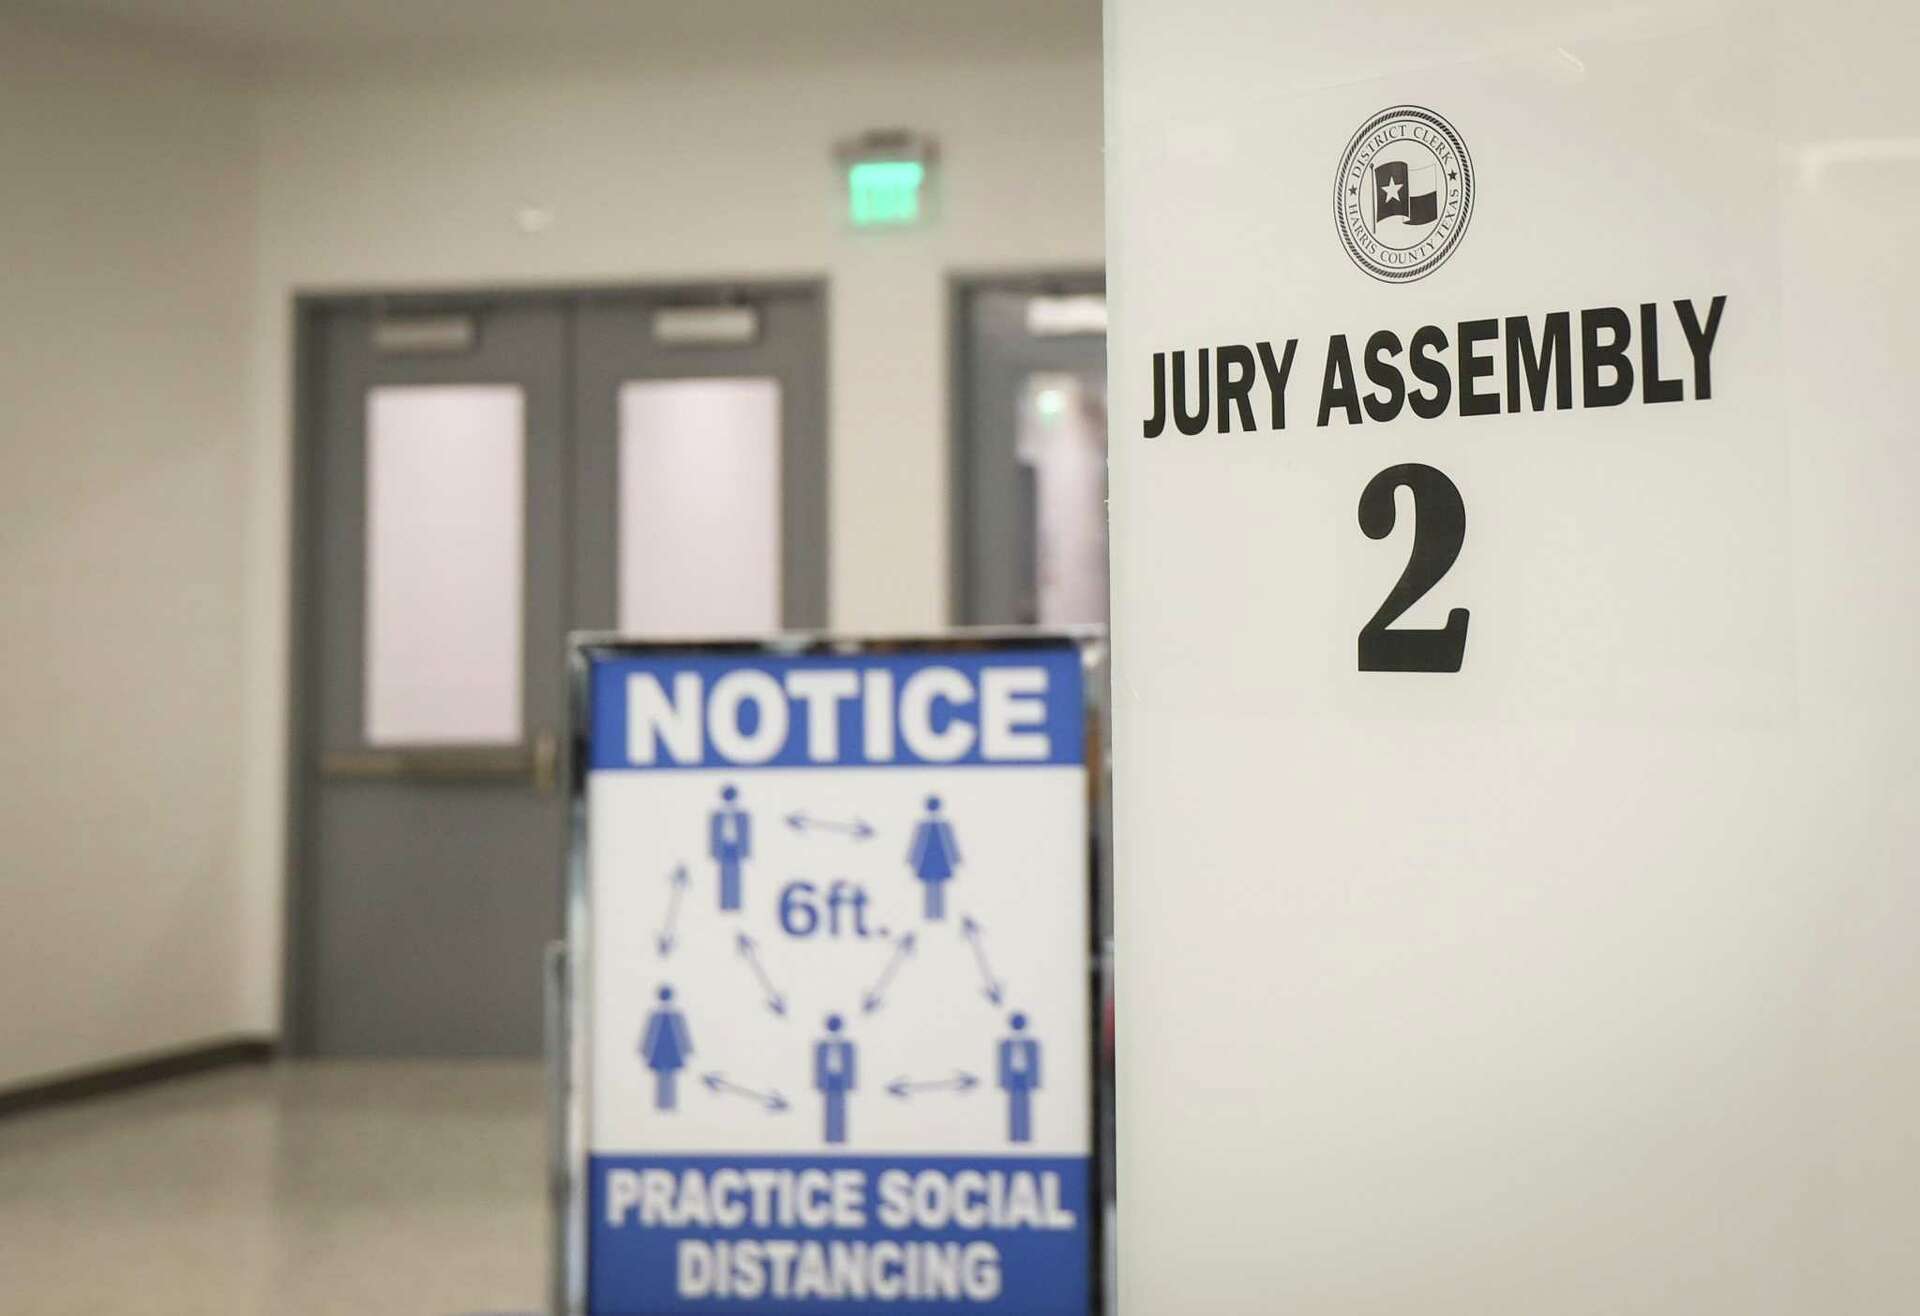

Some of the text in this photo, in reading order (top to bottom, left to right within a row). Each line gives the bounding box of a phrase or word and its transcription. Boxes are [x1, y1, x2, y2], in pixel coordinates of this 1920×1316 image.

[1353, 124, 1453, 179] DISTRICT CLERK
[1348, 188, 1459, 265] HARRIS COUNTY TEXAS
[1143, 294, 1728, 439] JURY ASSEMBLY
[1357, 462, 1470, 673] 2
[625, 666, 1052, 765] NOTICE
[777, 878, 890, 939] 6ft.
[605, 1167, 1076, 1231] PRACTICE SOCIAL
[676, 1238, 1001, 1300] DISTANCING
